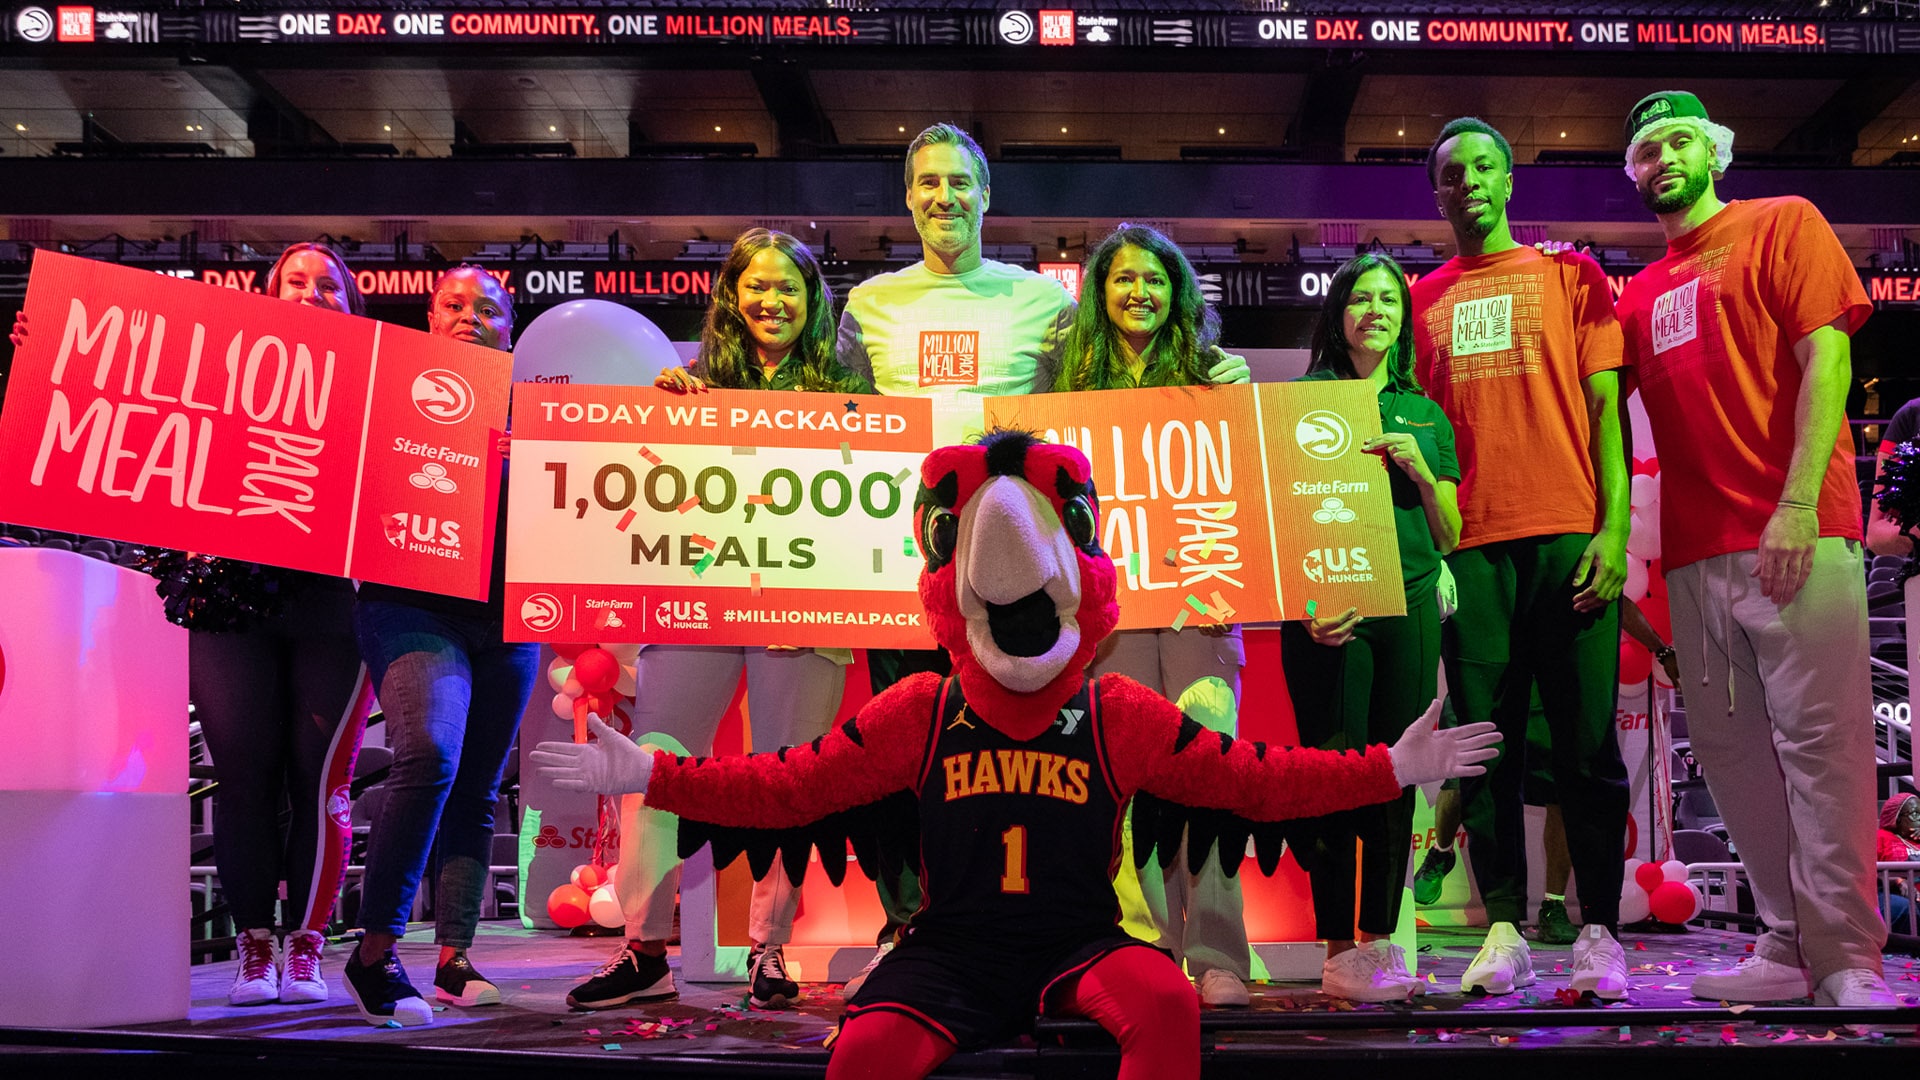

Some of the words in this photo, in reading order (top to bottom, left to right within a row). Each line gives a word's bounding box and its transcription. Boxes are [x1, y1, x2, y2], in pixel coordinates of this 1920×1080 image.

[279, 13, 331, 35] ONE
[336, 13, 387, 35] DAY.
[393, 13, 445, 35] ONE
[450, 13, 600, 35] COMMUNITY.
[608, 14, 659, 35] ONE
[666, 14, 764, 35] MILLION
[772, 15, 858, 36] MEALS.
[1258, 18, 1308, 40] ONE
[1315, 19, 1364, 41] DAY.
[1370, 20, 1421, 42] ONE
[1427, 21, 1574, 43] COMMUNITY.
[1580, 22, 1630, 43] ONE
[1637, 24, 1734, 44] MILLION
[1740, 25, 1825, 45] MEALS.
[203, 270, 262, 293] DAY.
[526, 271, 585, 294] ONE
[594, 271, 712, 295] MILLION
[1300, 272, 1336, 297] ON
[1457, 298, 1508, 323] MILLION
[1655, 282, 1696, 320] MILLION
[1457, 319, 1495, 343] MEAL
[1492, 315, 1507, 338] PACK
[1655, 312, 1684, 341] MEAL
[923, 334, 975, 354] MILLION
[50, 297, 336, 431] MILLION
[923, 353, 960, 377] MEAL
[958, 353, 975, 378] PACK
[540, 401, 655, 425] TODAY
[665, 406, 718, 428] WE
[730, 408, 907, 434] PACKAGED
[30, 389, 233, 515] MEAL
[1043, 419, 1233, 501] LLION
[236, 426, 325, 534] PACK
[544, 461, 902, 524] 1,000,000
[411, 514, 461, 549] U.S.
[1172, 500, 1245, 589] PACK
[409, 542, 460, 560] HUNGER
[630, 533, 817, 570] MEALS
[1100, 505, 1178, 591] AL
[1323, 546, 1373, 572] U.S.
[1327, 573, 1374, 583] HUNGER
[673, 601, 709, 620] U.S.
[723, 609, 921, 627] #MILLIONMEALPACK
[673, 621, 709, 630] HUNGER
[943, 749, 1090, 805] HAWKS
[1001, 824, 1030, 894] 1
